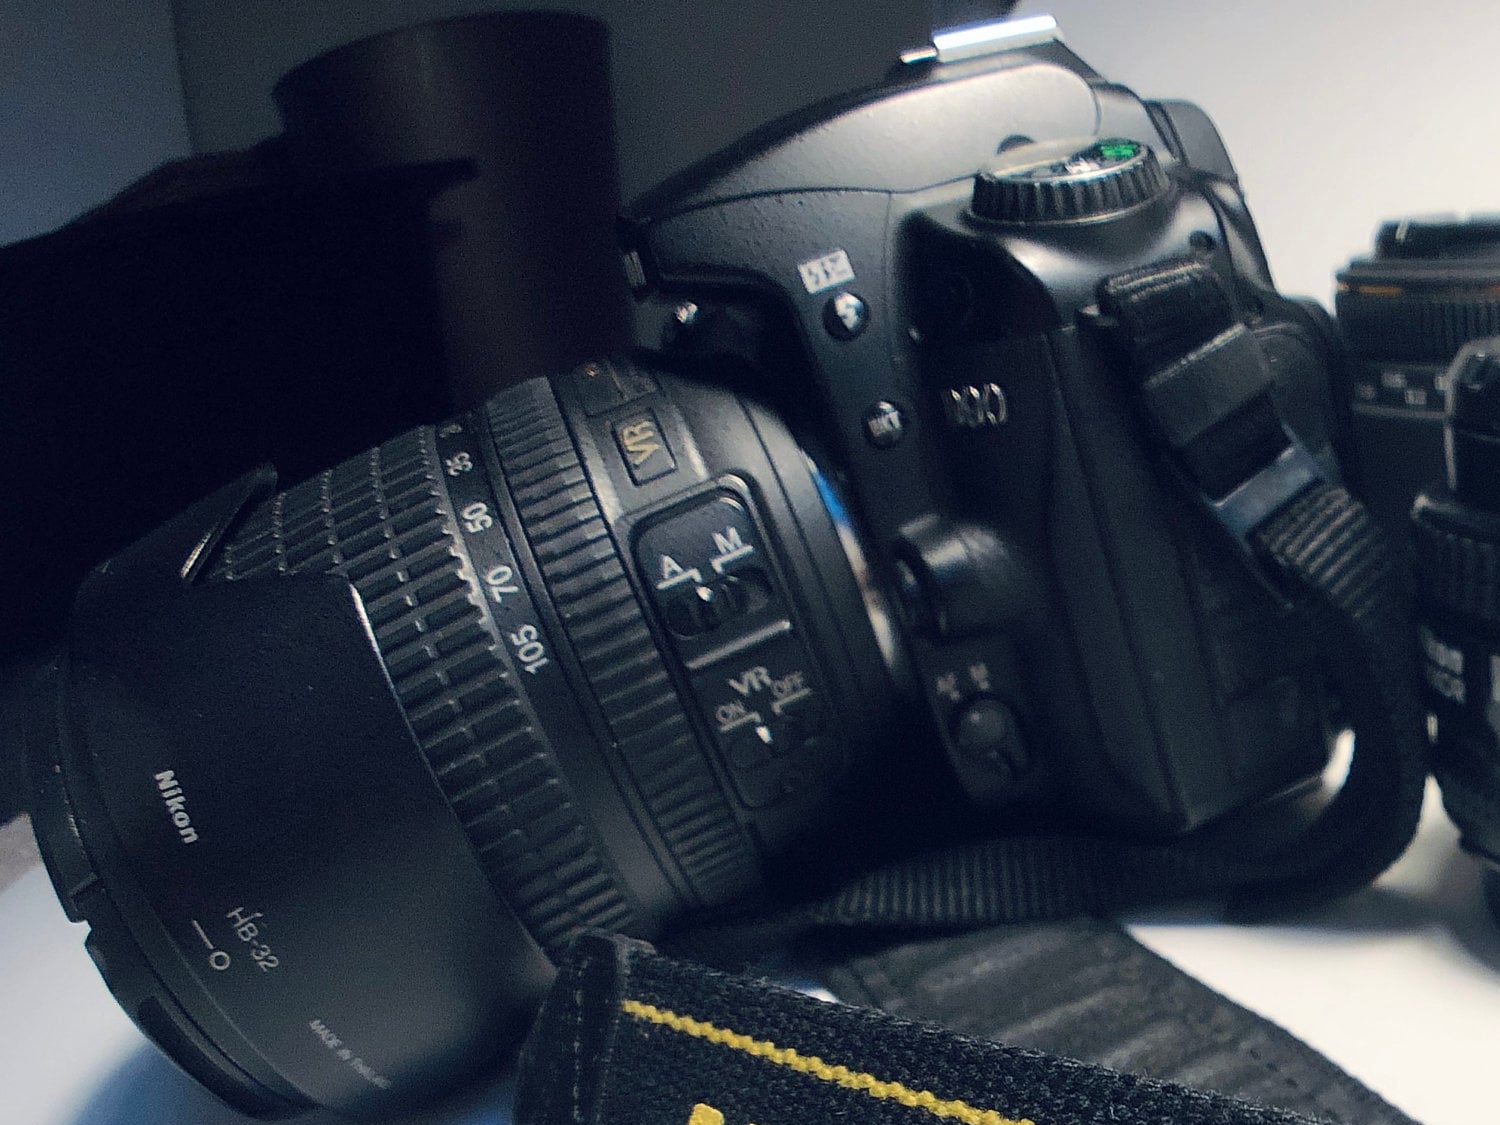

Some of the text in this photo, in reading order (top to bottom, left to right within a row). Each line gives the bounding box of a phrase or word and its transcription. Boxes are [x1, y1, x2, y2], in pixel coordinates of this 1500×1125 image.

[622, 421, 660, 466] VR
[446, 452, 473, 477] 35
[462, 502, 493, 534] 50
[711, 527, 745, 555] M
[485, 565, 519, 602] 70
[660, 555, 685, 581] A
[510, 625, 550, 674] 105
[727, 666, 771, 696] VR
[155, 769, 198, 844] Nikon
[227, 907, 279, 972] HB-32
